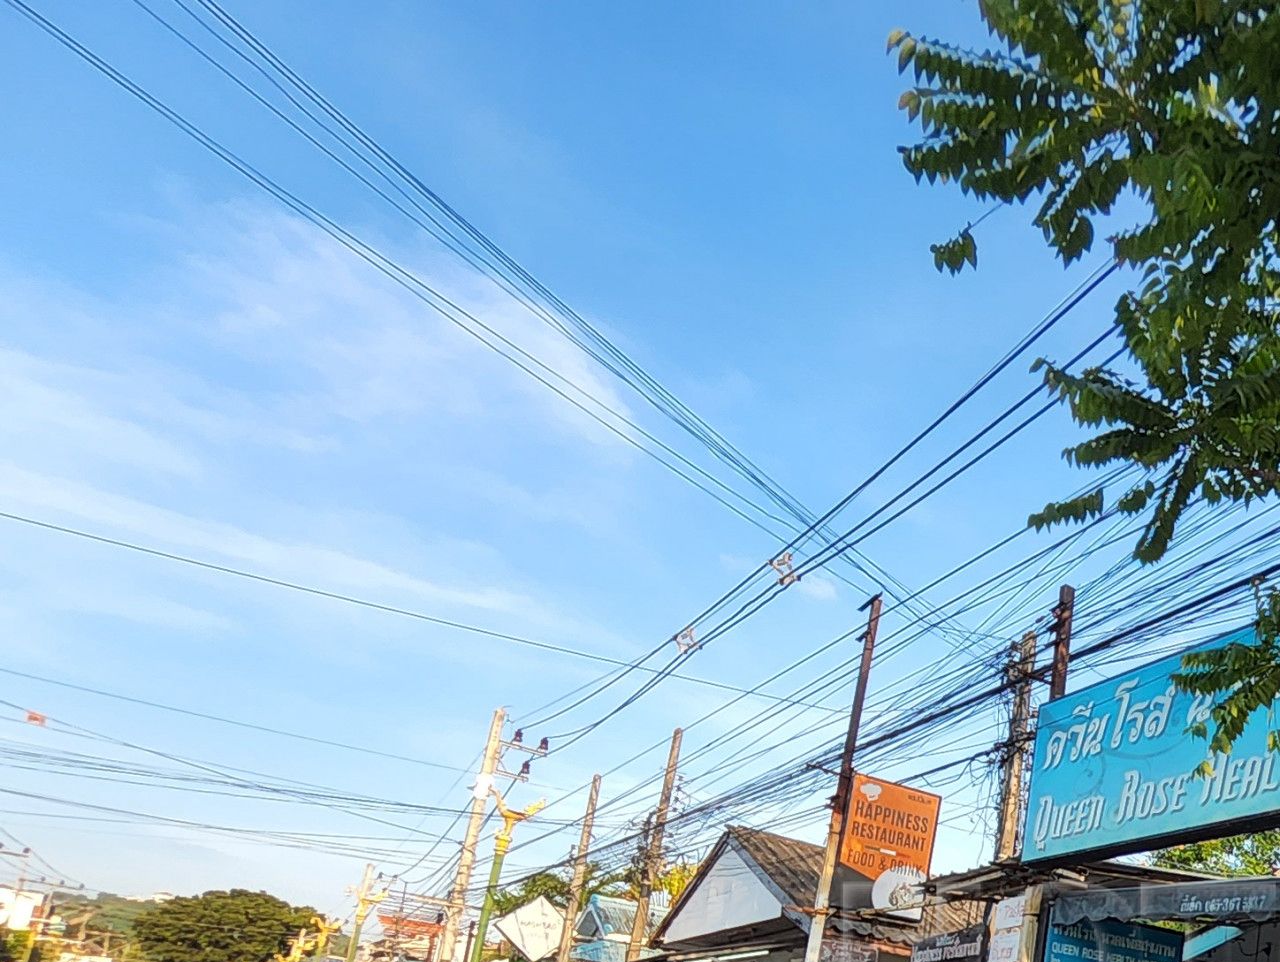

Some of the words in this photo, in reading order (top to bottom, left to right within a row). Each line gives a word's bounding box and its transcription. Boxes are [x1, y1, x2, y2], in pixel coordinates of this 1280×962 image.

[1116, 770, 1193, 825] ROSE
[855, 800, 929, 833] HAPPINESS
[851, 821, 927, 851] RESTAURANT
[847, 848, 875, 868] FOOD
[878, 857, 887, 871] &
[889, 858, 923, 878] DRINK
